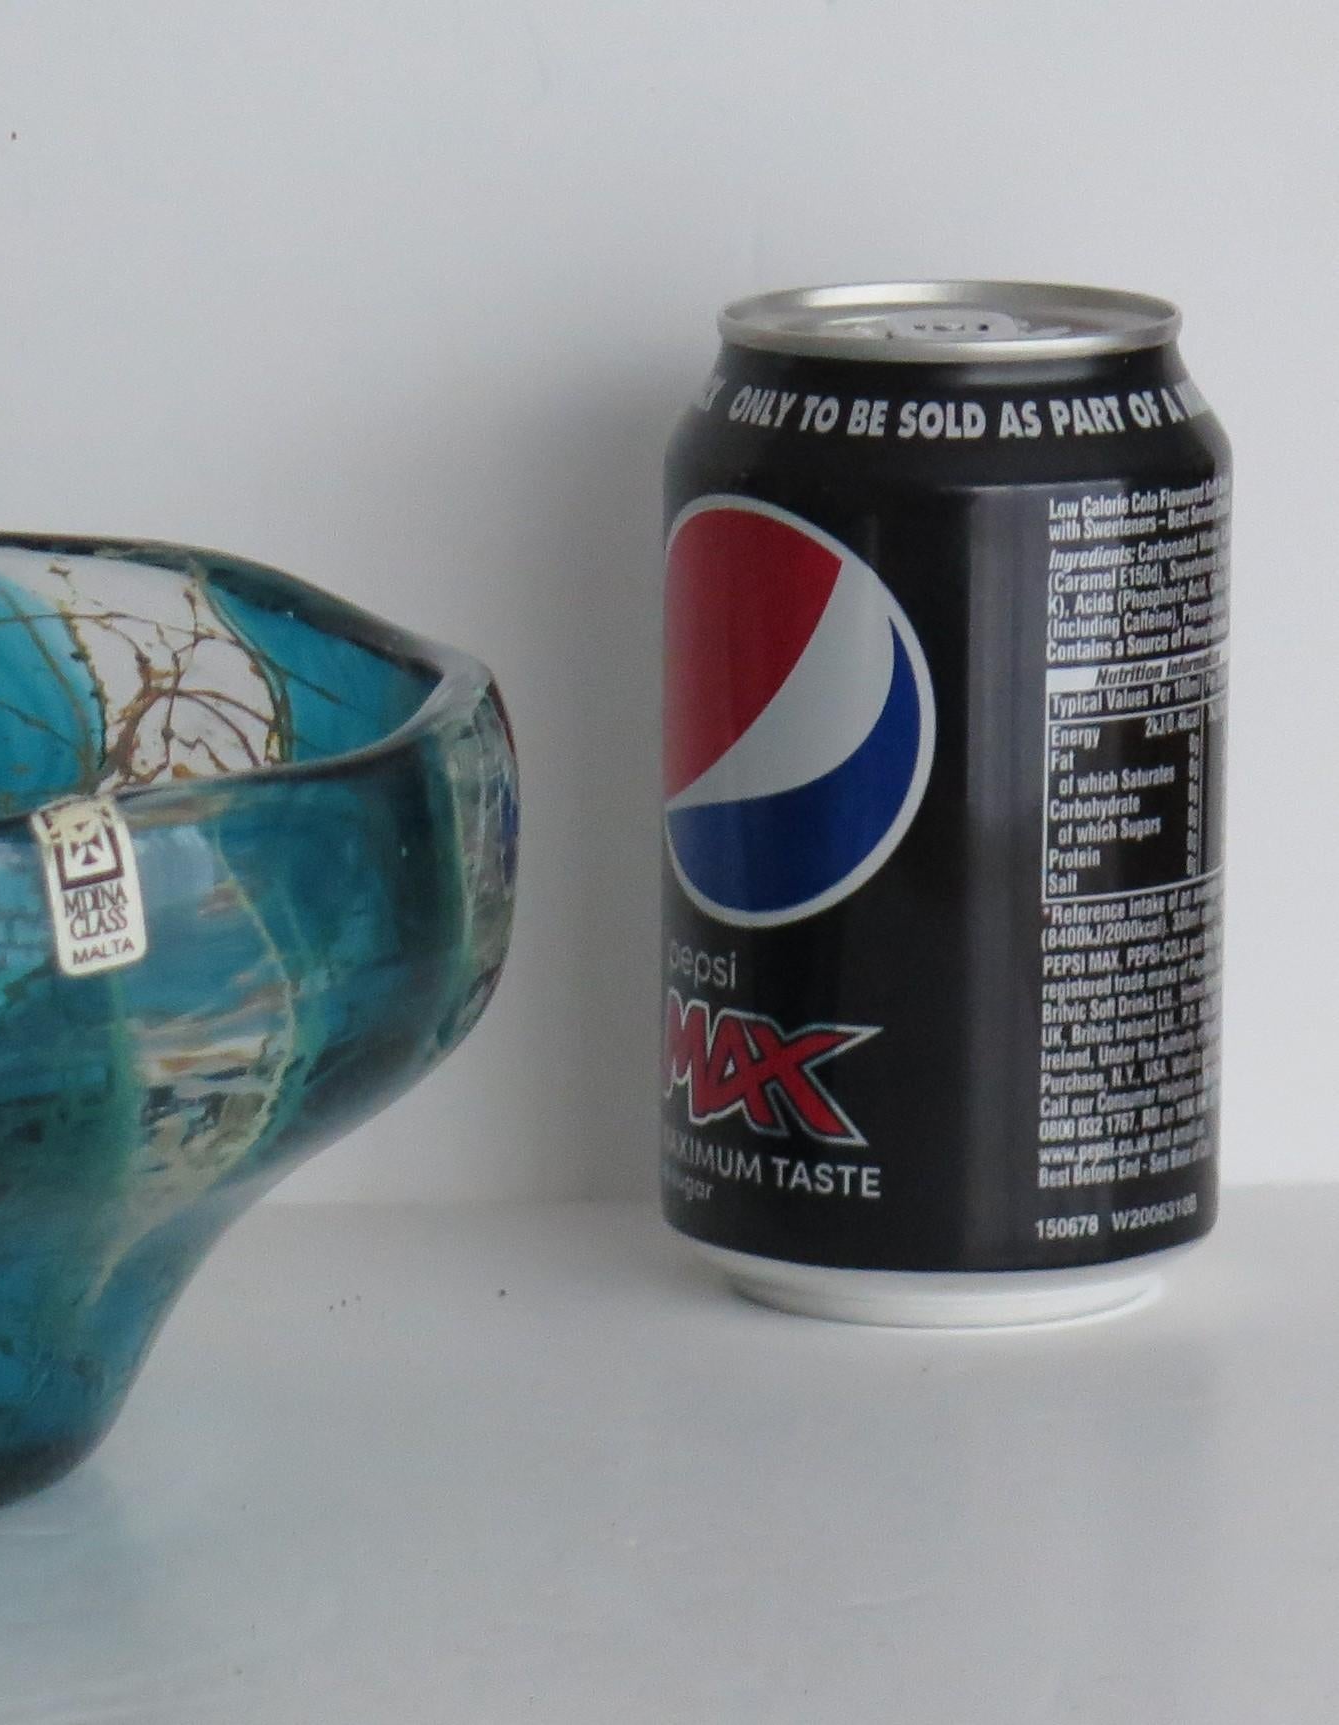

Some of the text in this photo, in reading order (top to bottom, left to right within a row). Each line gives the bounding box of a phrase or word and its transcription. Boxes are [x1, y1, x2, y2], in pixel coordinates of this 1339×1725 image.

[728, 384, 798, 428] ONLY
[799, 394, 840, 433] TO
[847, 398, 889, 437] BE
[897, 399, 987, 439] SOLD
[999, 400, 1042, 439] AS
[1049, 394, 1126, 436] PART
[1128, 390, 1162, 428] OF
[1050, 498, 1079, 519] Low
[1082, 492, 1130, 516] Calorie
[1131, 490, 1158, 512] Cola
[1050, 519, 1081, 541] with
[1084, 515, 1157, 539] Sweeteners
[1049, 546, 1136, 573] Ingredients:
[1138, 535, 1199, 562] Carbonated
[1048, 568, 1116, 593] (Caramel
[1074, 592, 1114, 614] Acids
[1047, 615, 1121, 639] (Including
[1047, 638, 1113, 662] Contains
[1115, 641, 1125, 658] a
[1127, 634, 1169, 656] Source
[1171, 627, 1182, 647] of
[1095, 662, 1164, 687] Nutrition
[1052, 690, 1103, 716] Typical
[1106, 687, 1150, 713] Values
[1152, 683, 1173, 705] Per
[1051, 724, 1101, 749] Energy
[1051, 751, 1076, 772] Fat
[1059, 774, 1074, 795] of
[1077, 770, 1118, 793] which
[1122, 764, 1175, 789] Saturates
[1050, 794, 1141, 821] Carbohydrate
[1058, 823, 1073, 844] of
[1076, 820, 1117, 843] which
[1121, 816, 1162, 841] Sugars
[1049, 846, 1101, 869] Protein
[1048, 872, 1078, 895] Salt
[63, 881, 129, 918] MDINA
[70, 905, 129, 941] GLASS
[73, 937, 136, 966] MALTA
[1043, 953, 1086, 977] PEPSI
[1042, 976, 1113, 1004] registered
[1115, 971, 1146, 992] trade
[1042, 1001, 1087, 1024] Britvic
[1090, 997, 1116, 1021] Soft
[1118, 992, 1155, 1016] Drinks
[1072, 1022, 1114, 1046] Britvic
[665, 985, 884, 1147] MAX
[1098, 1042, 1136, 1066] Under
[1041, 1095, 1068, 1118] Call
[1072, 1097, 1095, 1116] our
[1039, 1118, 1075, 1142] 0800
[1078, 1115, 1104, 1138] 032
[771, 1156, 882, 1199] TASTE
[1038, 1166, 1071, 1189] Best
[1073, 1161, 1117, 1187] Before
[1118, 1157, 1142, 1181] End
[1035, 1213, 1100, 1241] 150678
